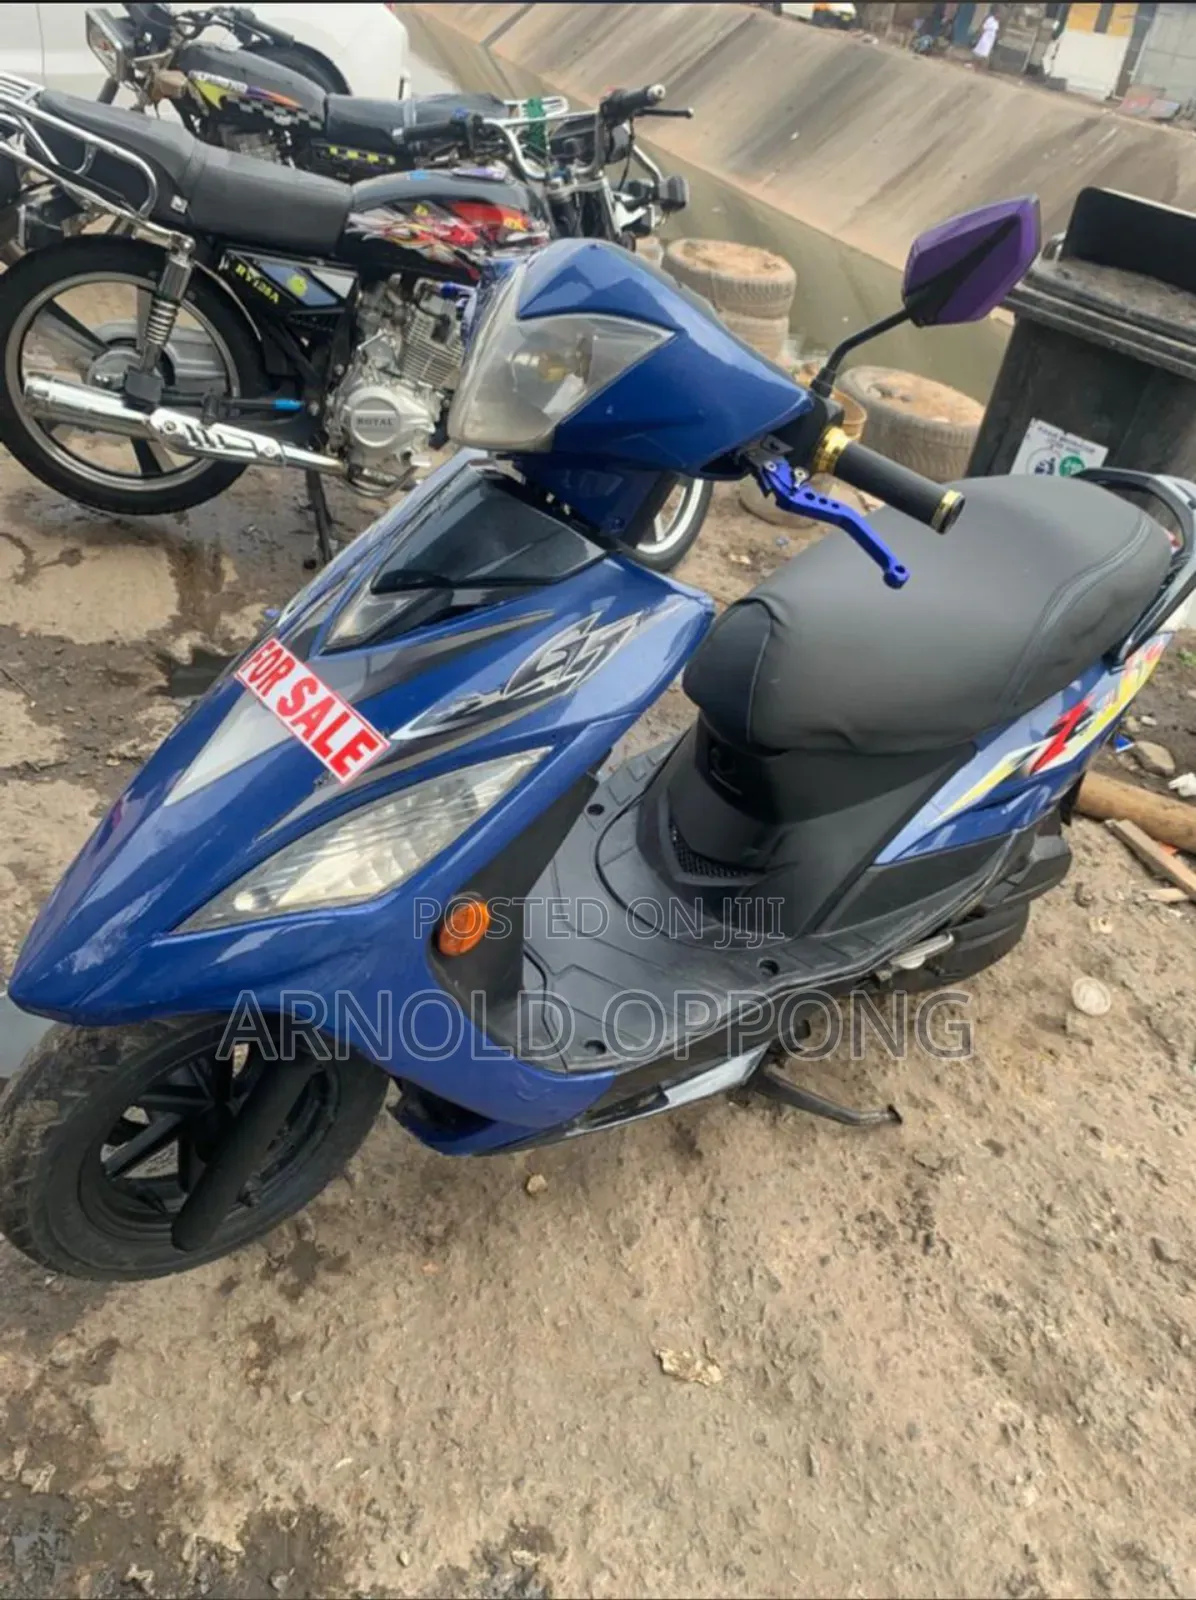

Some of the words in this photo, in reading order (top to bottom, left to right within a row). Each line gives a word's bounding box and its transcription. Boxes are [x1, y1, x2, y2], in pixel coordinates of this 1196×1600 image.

[356, 415, 395, 428] ROYAL
[240, 640, 297, 698] FOR
[276, 676, 380, 778] SALE
